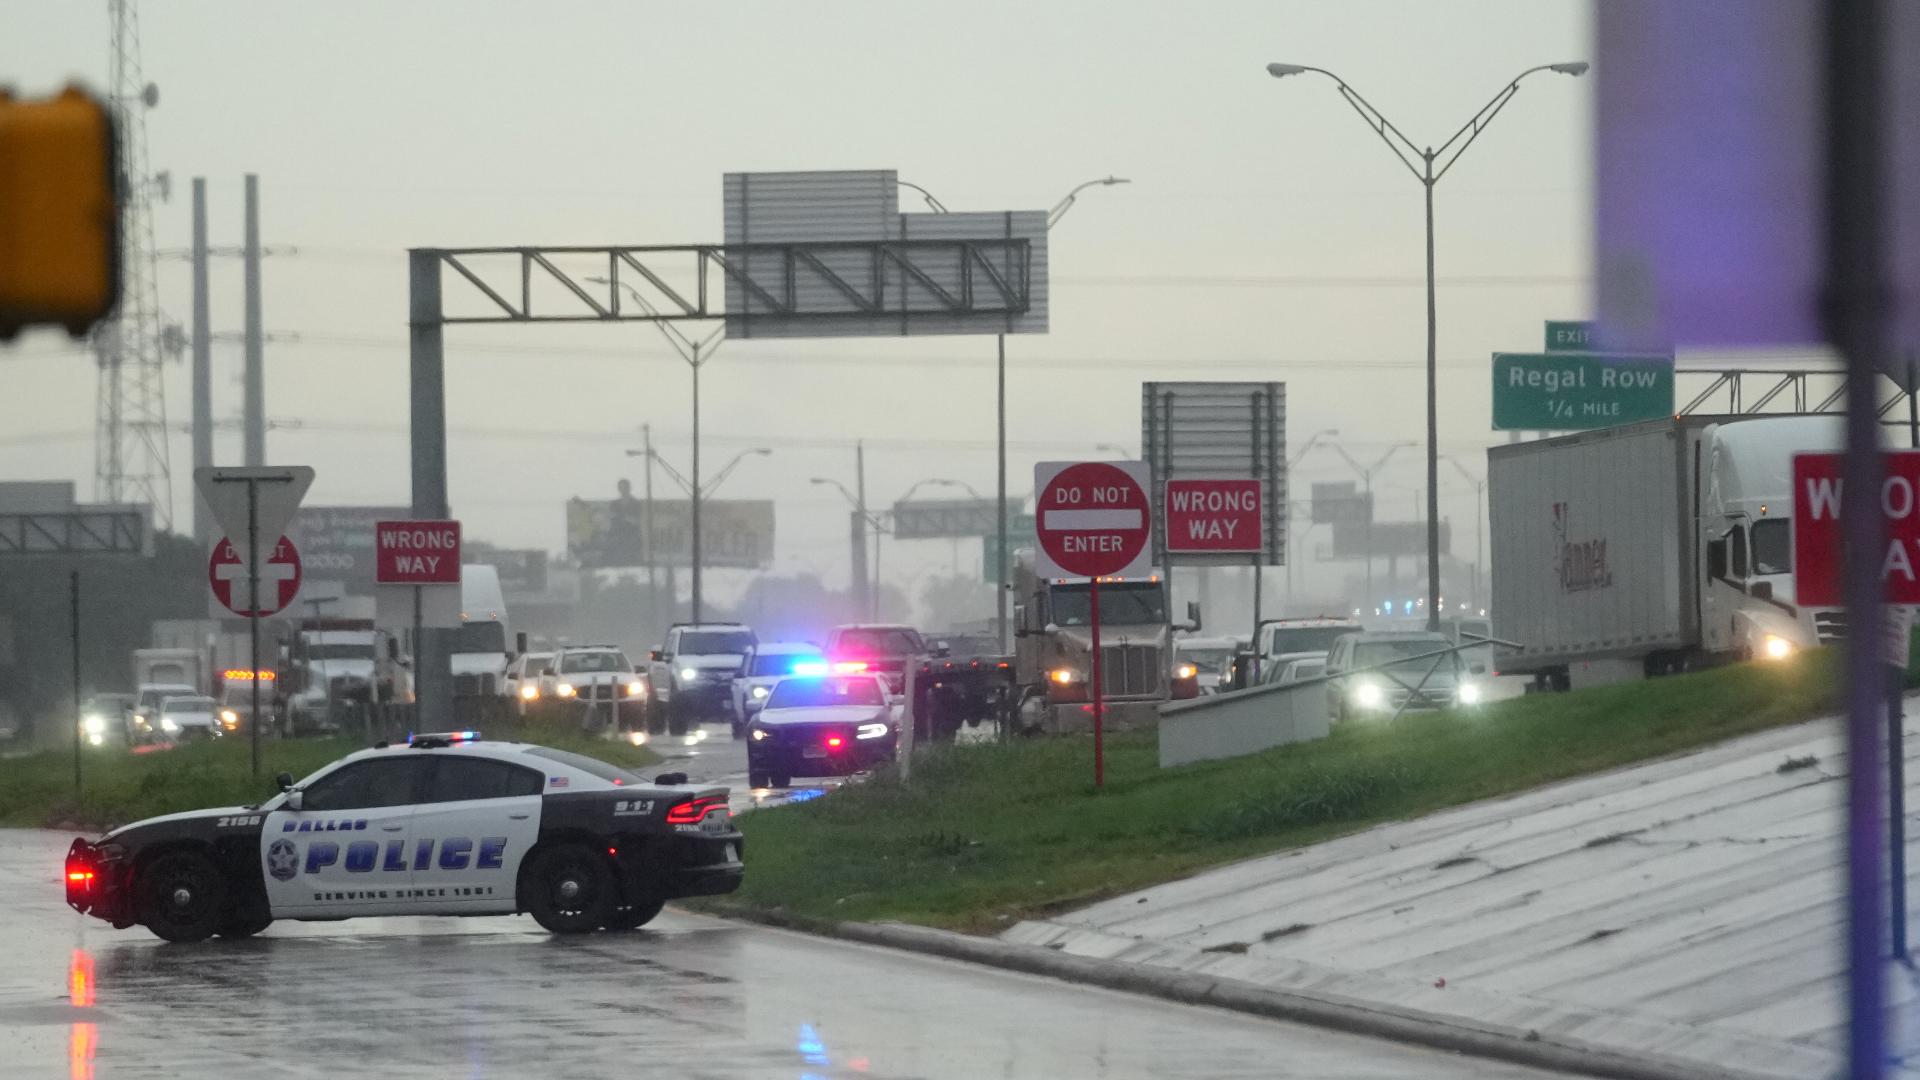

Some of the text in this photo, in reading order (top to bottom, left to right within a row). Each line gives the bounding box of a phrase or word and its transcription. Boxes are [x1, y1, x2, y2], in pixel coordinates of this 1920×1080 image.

[1509, 366, 1657, 392] Regal Row
[1549, 401, 1621, 418] 1/4 MILE
[1056, 487, 1131, 504] DO NOT
[1171, 490, 1257, 513] WRONG
[1188, 519, 1239, 540] WAY
[381, 530, 457, 550] WRONG
[1063, 535, 1124, 553] ENTER
[395, 556, 442, 575] WAY
[282, 818, 368, 833] DALLAS
[304, 837, 508, 874] POLICE
[314, 890, 388, 901] SERVING
[396, 888, 446, 899] SINCE
